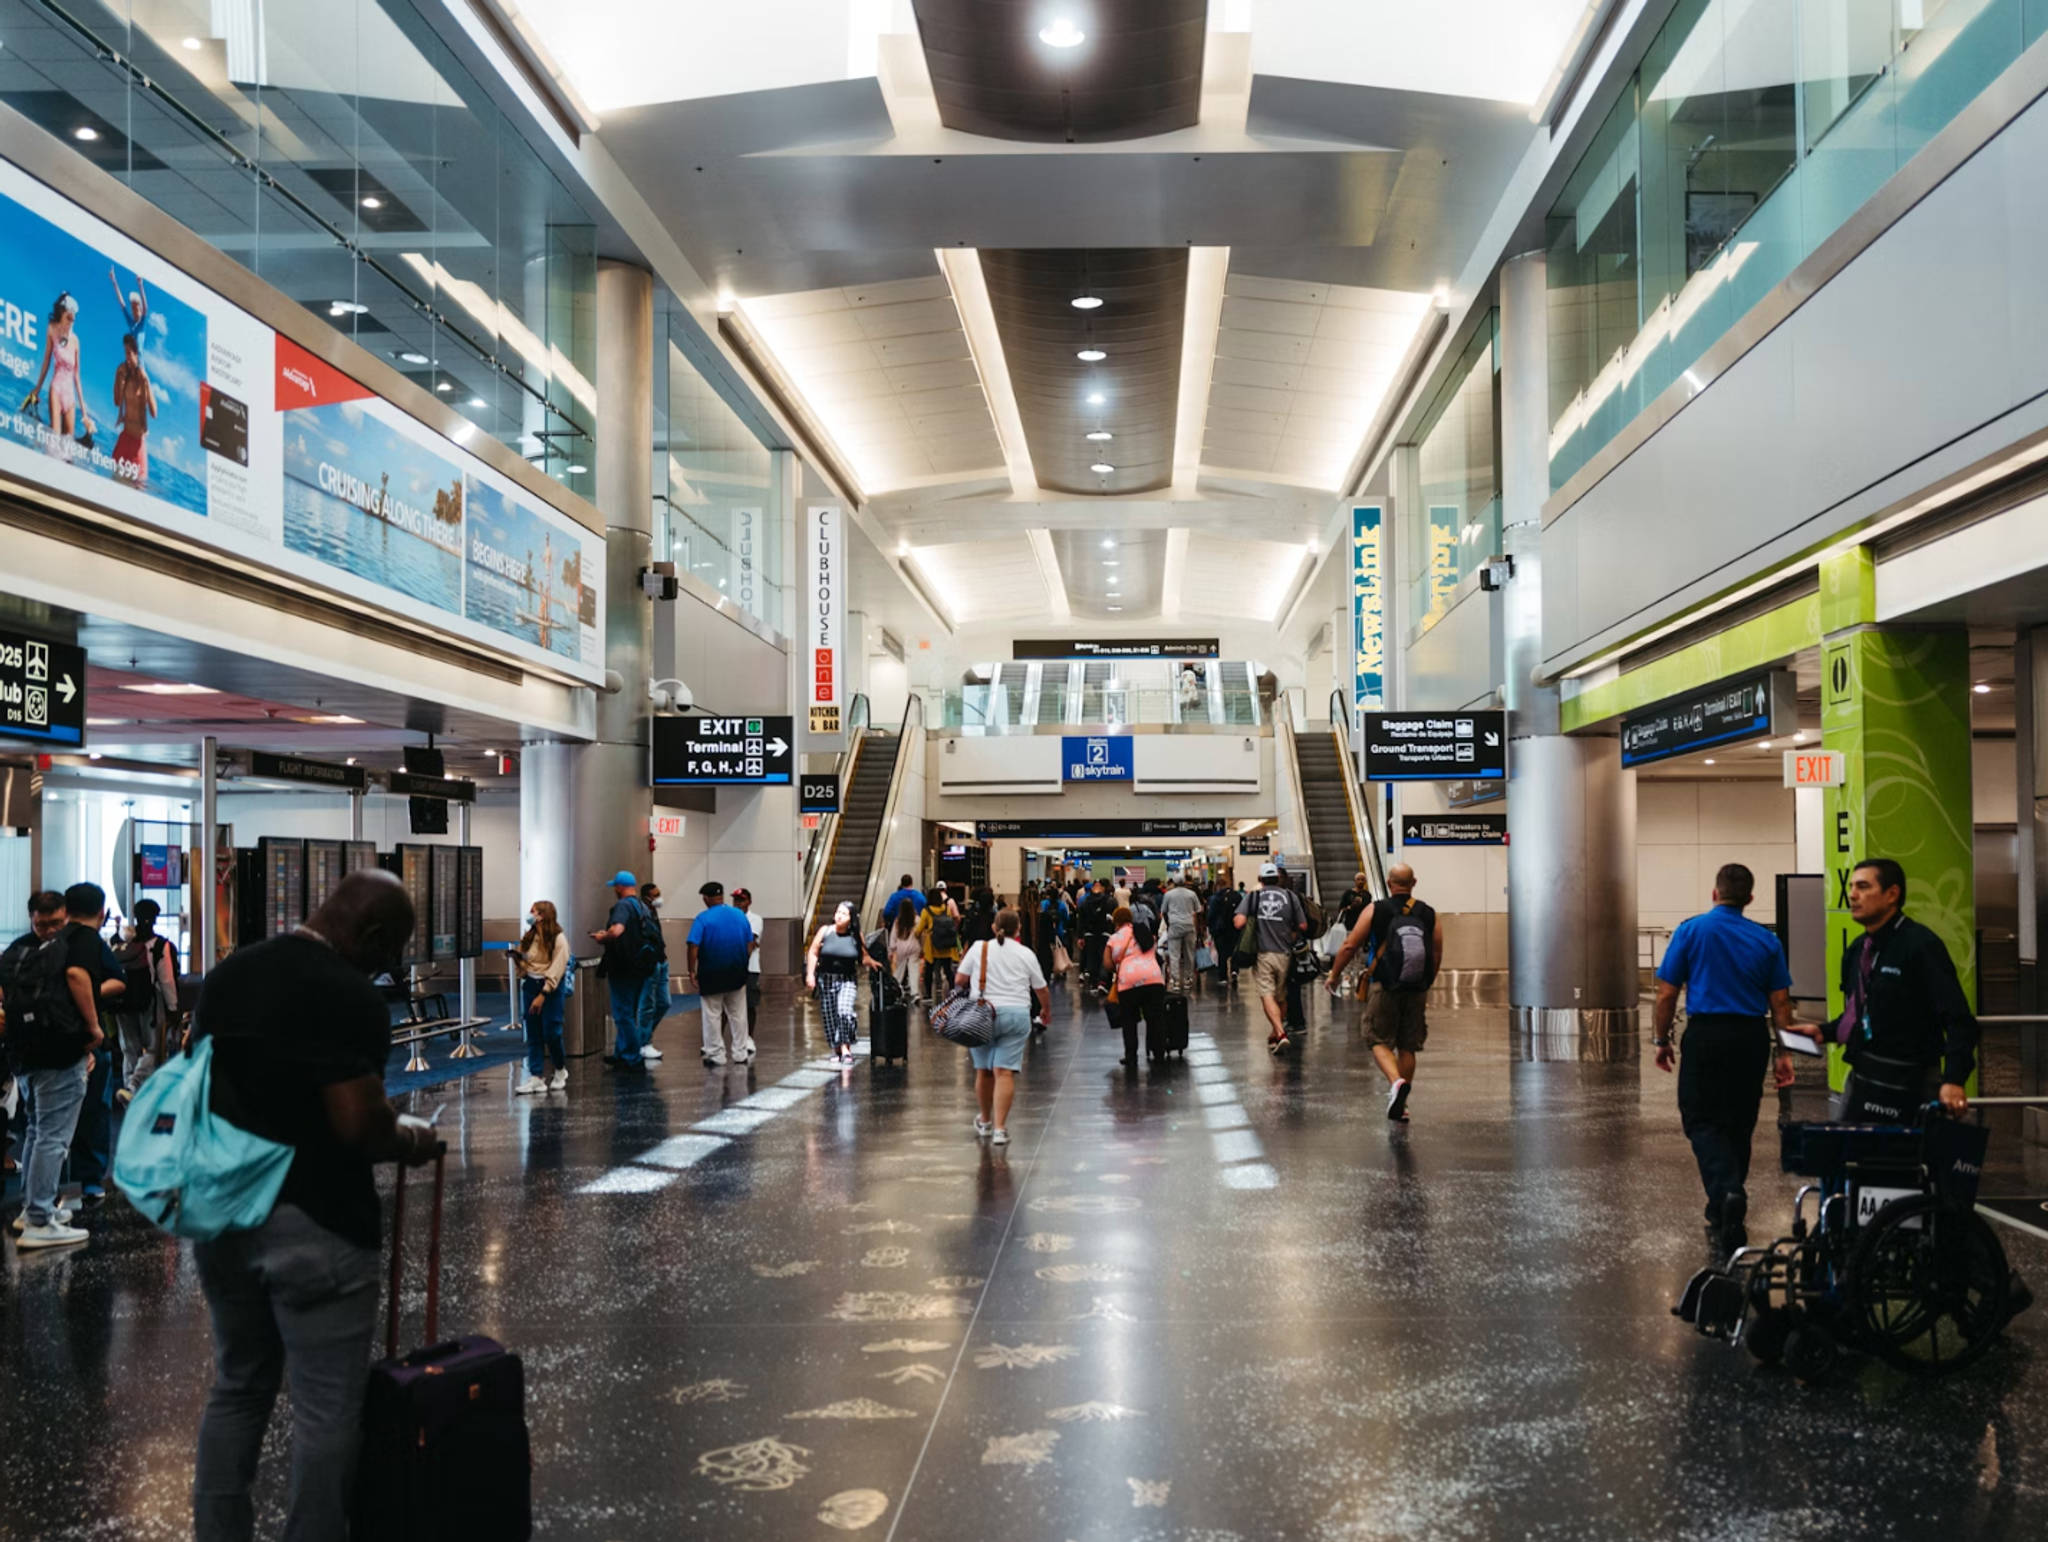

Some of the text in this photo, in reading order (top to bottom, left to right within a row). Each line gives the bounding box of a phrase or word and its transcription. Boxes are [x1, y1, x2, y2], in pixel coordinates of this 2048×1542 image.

[13, 416, 34, 438] the
[36, 422, 61, 449] first
[91, 447, 117, 472] then
[319, 461, 380, 514] CRUISING
[381, 493, 421, 533] ALONG
[819, 511, 830, 646] CLUBHOUSE
[1354, 524, 1382, 677] NewsLink
[818, 652, 830, 700] one
[7, 708, 22, 721] D15
[810, 706, 840, 718] KITCHEN
[700, 719, 744, 736] EXIT
[810, 719, 840, 731] & BAR
[1382, 719, 1453, 731] Baggage Claim
[686, 741, 743, 753] Terminal
[1092, 746, 1104, 762] 2
[1371, 743, 1454, 755] Ground Transport
[687, 761, 744, 774] F, G, H, J
[1085, 764, 1125, 778] skytrain
[1796, 755, 1831, 783] EXIT
[804, 785, 835, 799] D25
[658, 817, 681, 834] EXIT
[803, 817, 819, 828] EXIT
[1863, 1100, 1900, 1118] envoy
